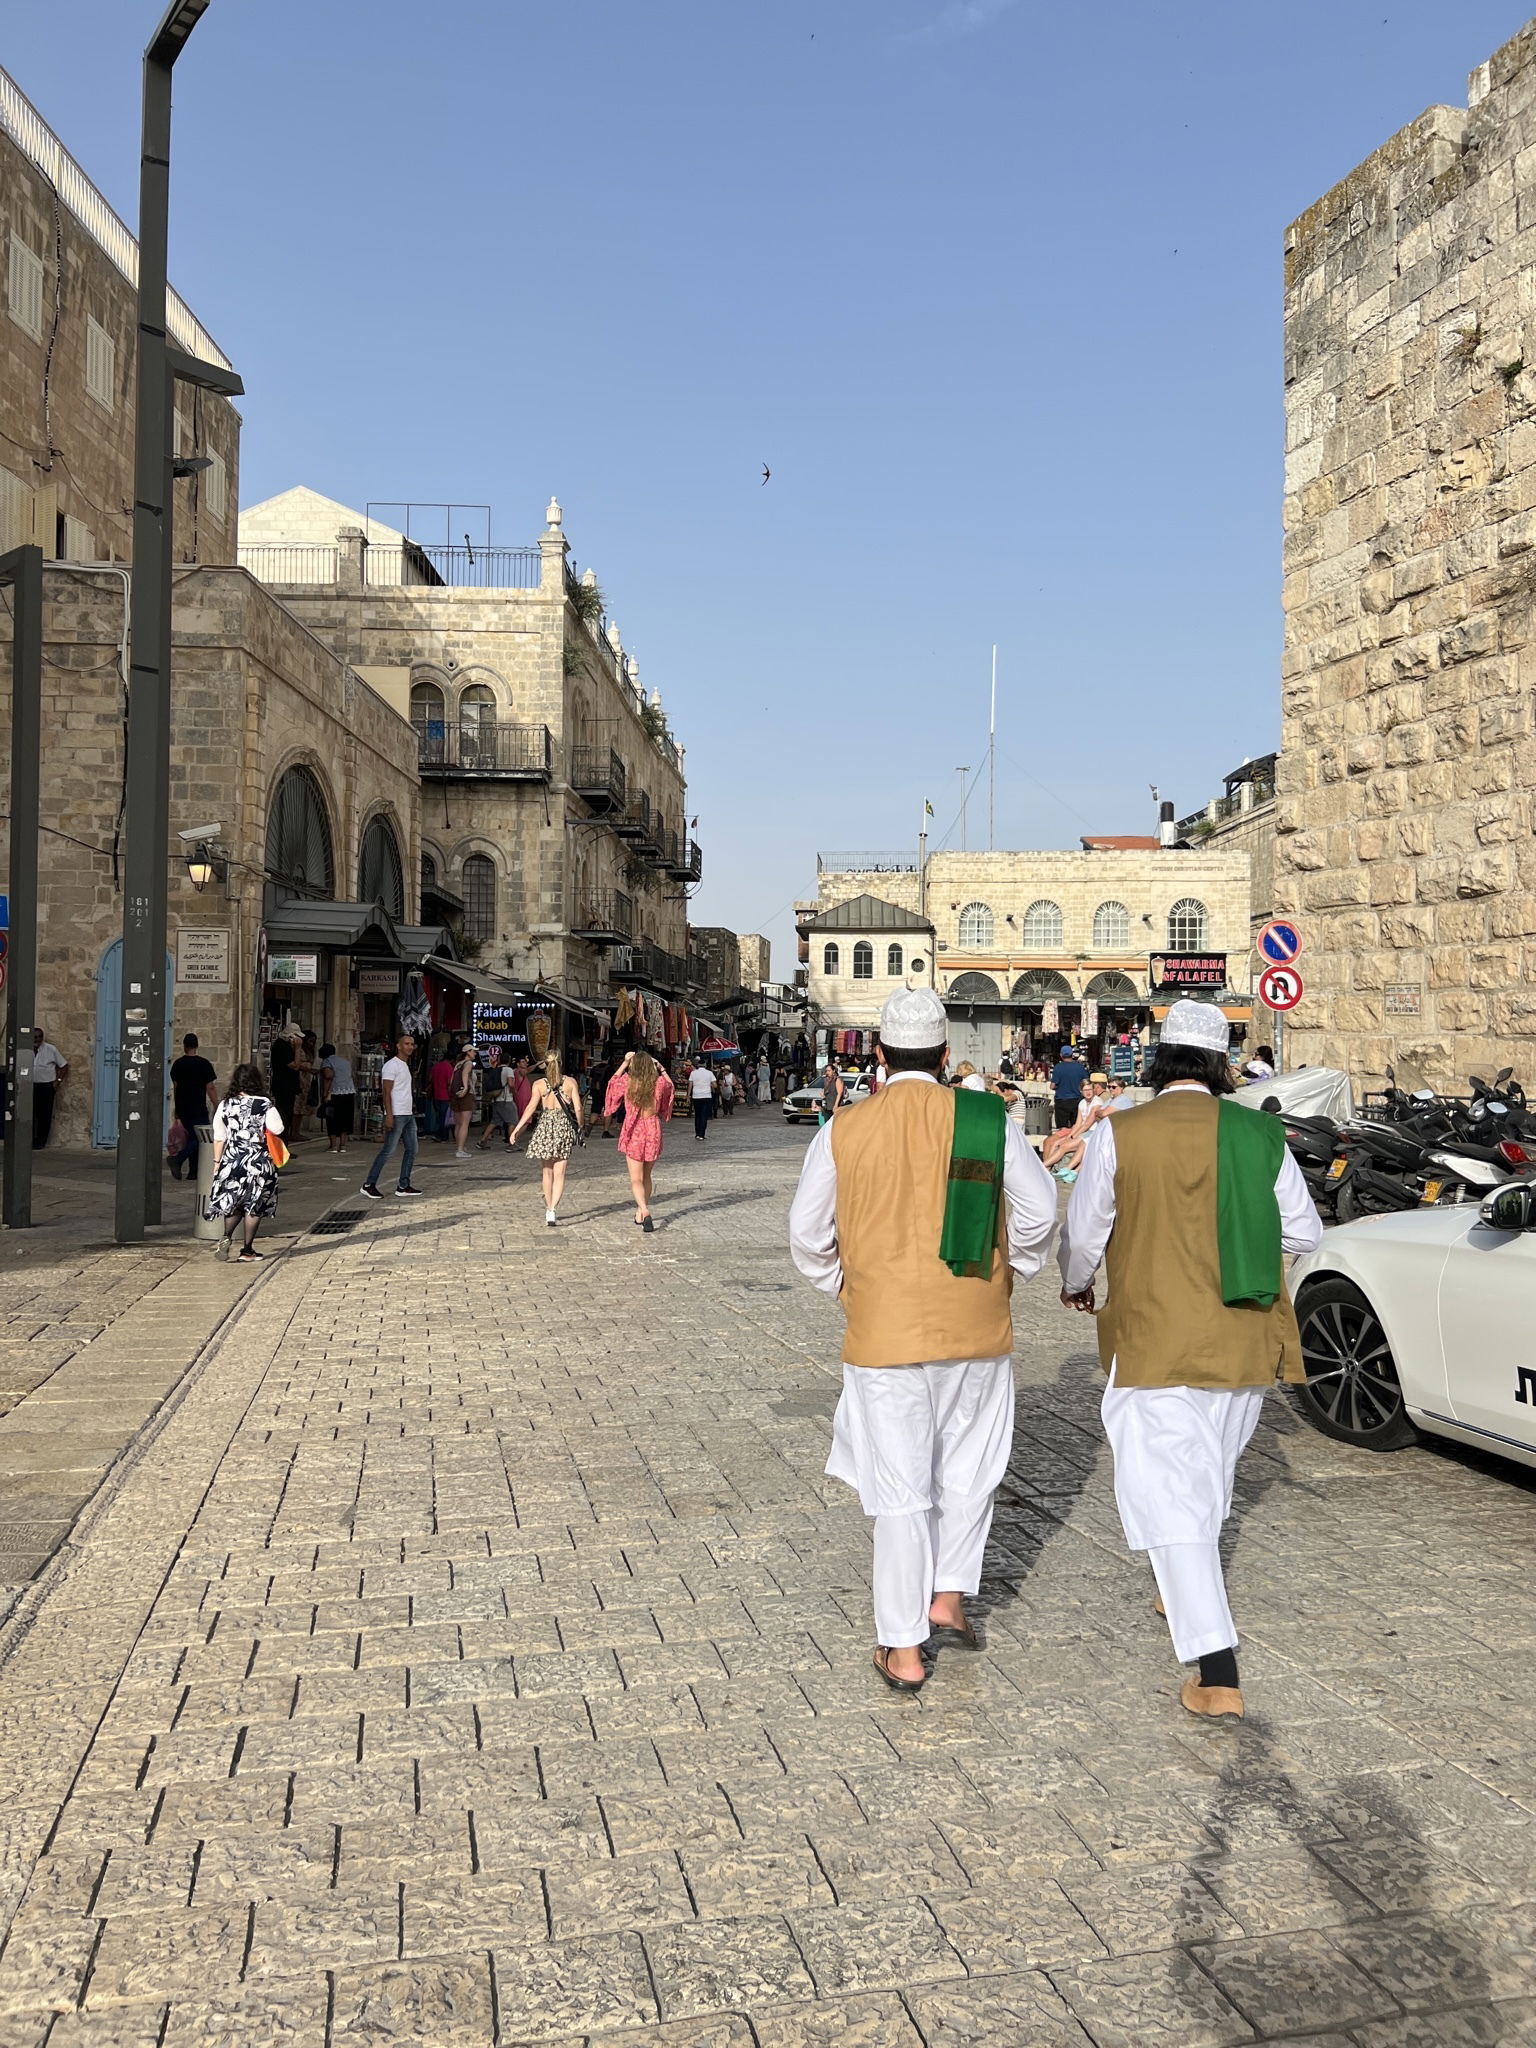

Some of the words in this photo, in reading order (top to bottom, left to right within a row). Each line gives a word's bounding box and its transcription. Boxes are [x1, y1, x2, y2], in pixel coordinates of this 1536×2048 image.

[1166, 959, 1225, 970] SHAWARMA
[477, 1006, 513, 1018] Falafel
[477, 1020, 509, 1030] Kabab
[477, 1032, 527, 1042] Shawarma
[491, 1047, 500, 1055] 12
